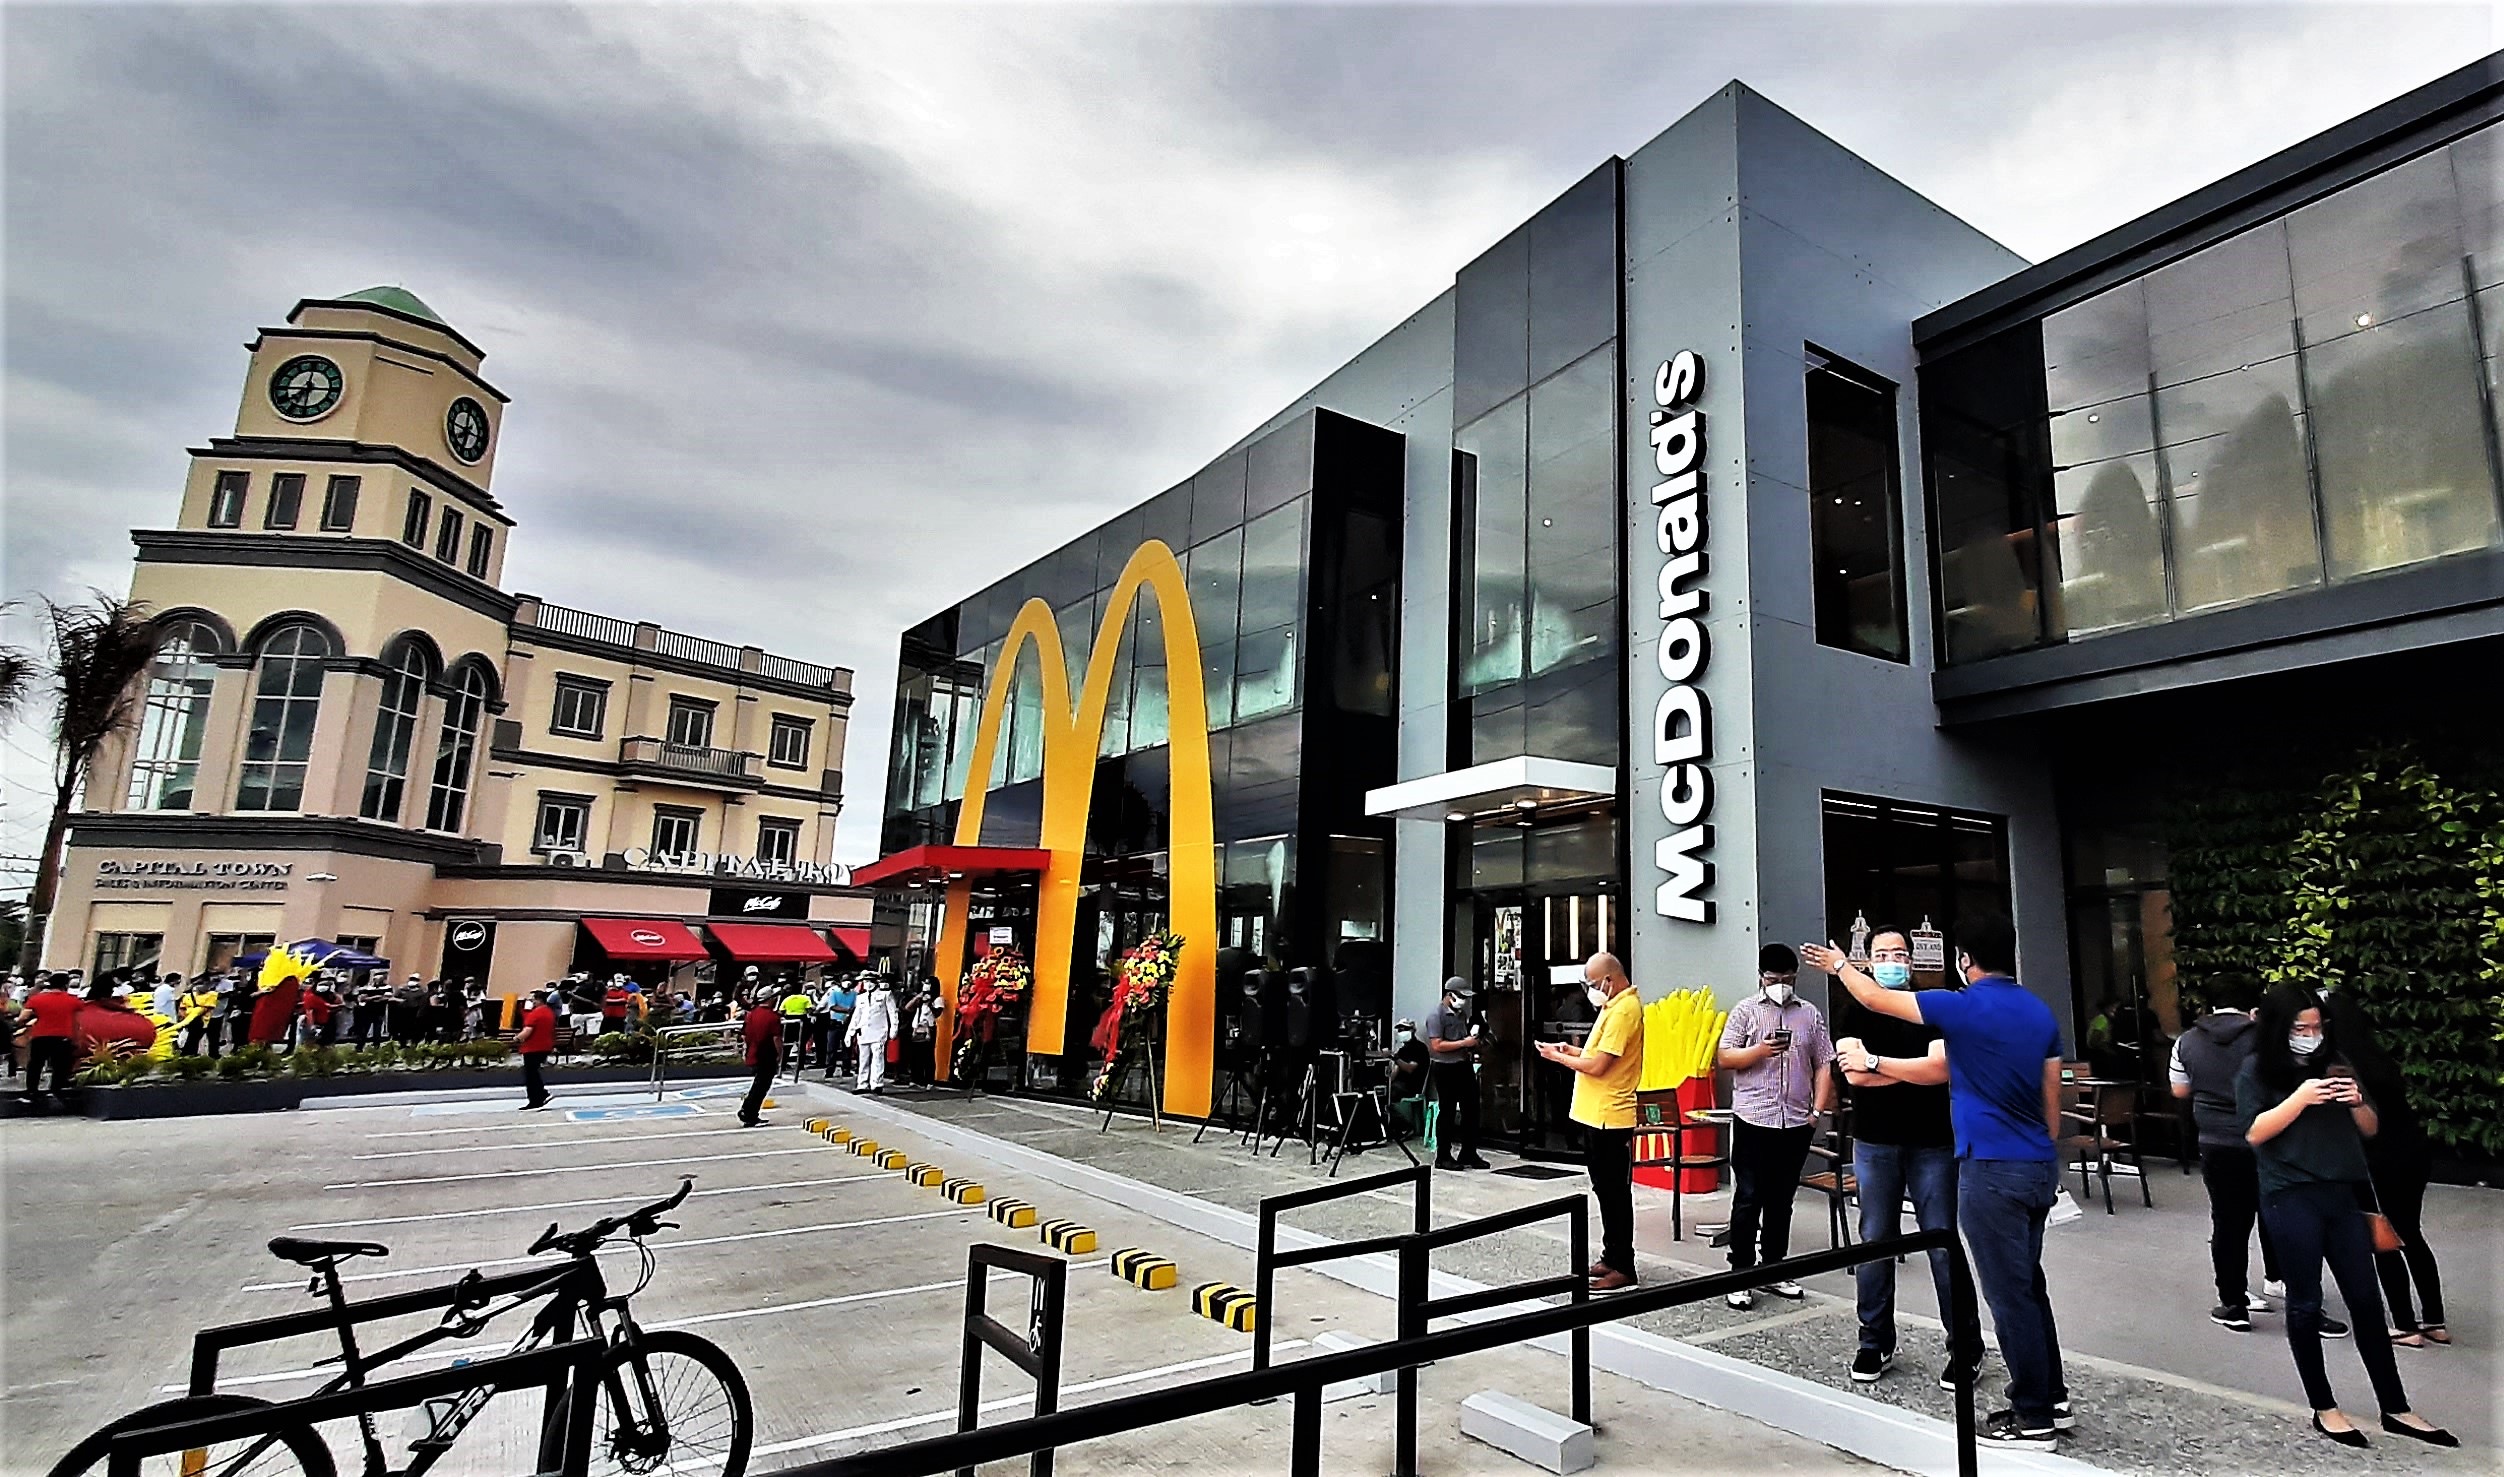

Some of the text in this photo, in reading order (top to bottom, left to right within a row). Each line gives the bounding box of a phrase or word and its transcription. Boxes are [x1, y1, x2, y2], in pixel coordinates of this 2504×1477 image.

[1650, 348, 1714, 924] McDonald's
[98, 859, 294, 876] CAPITAL TOWN
[622, 847, 794, 882] CAPITAL
